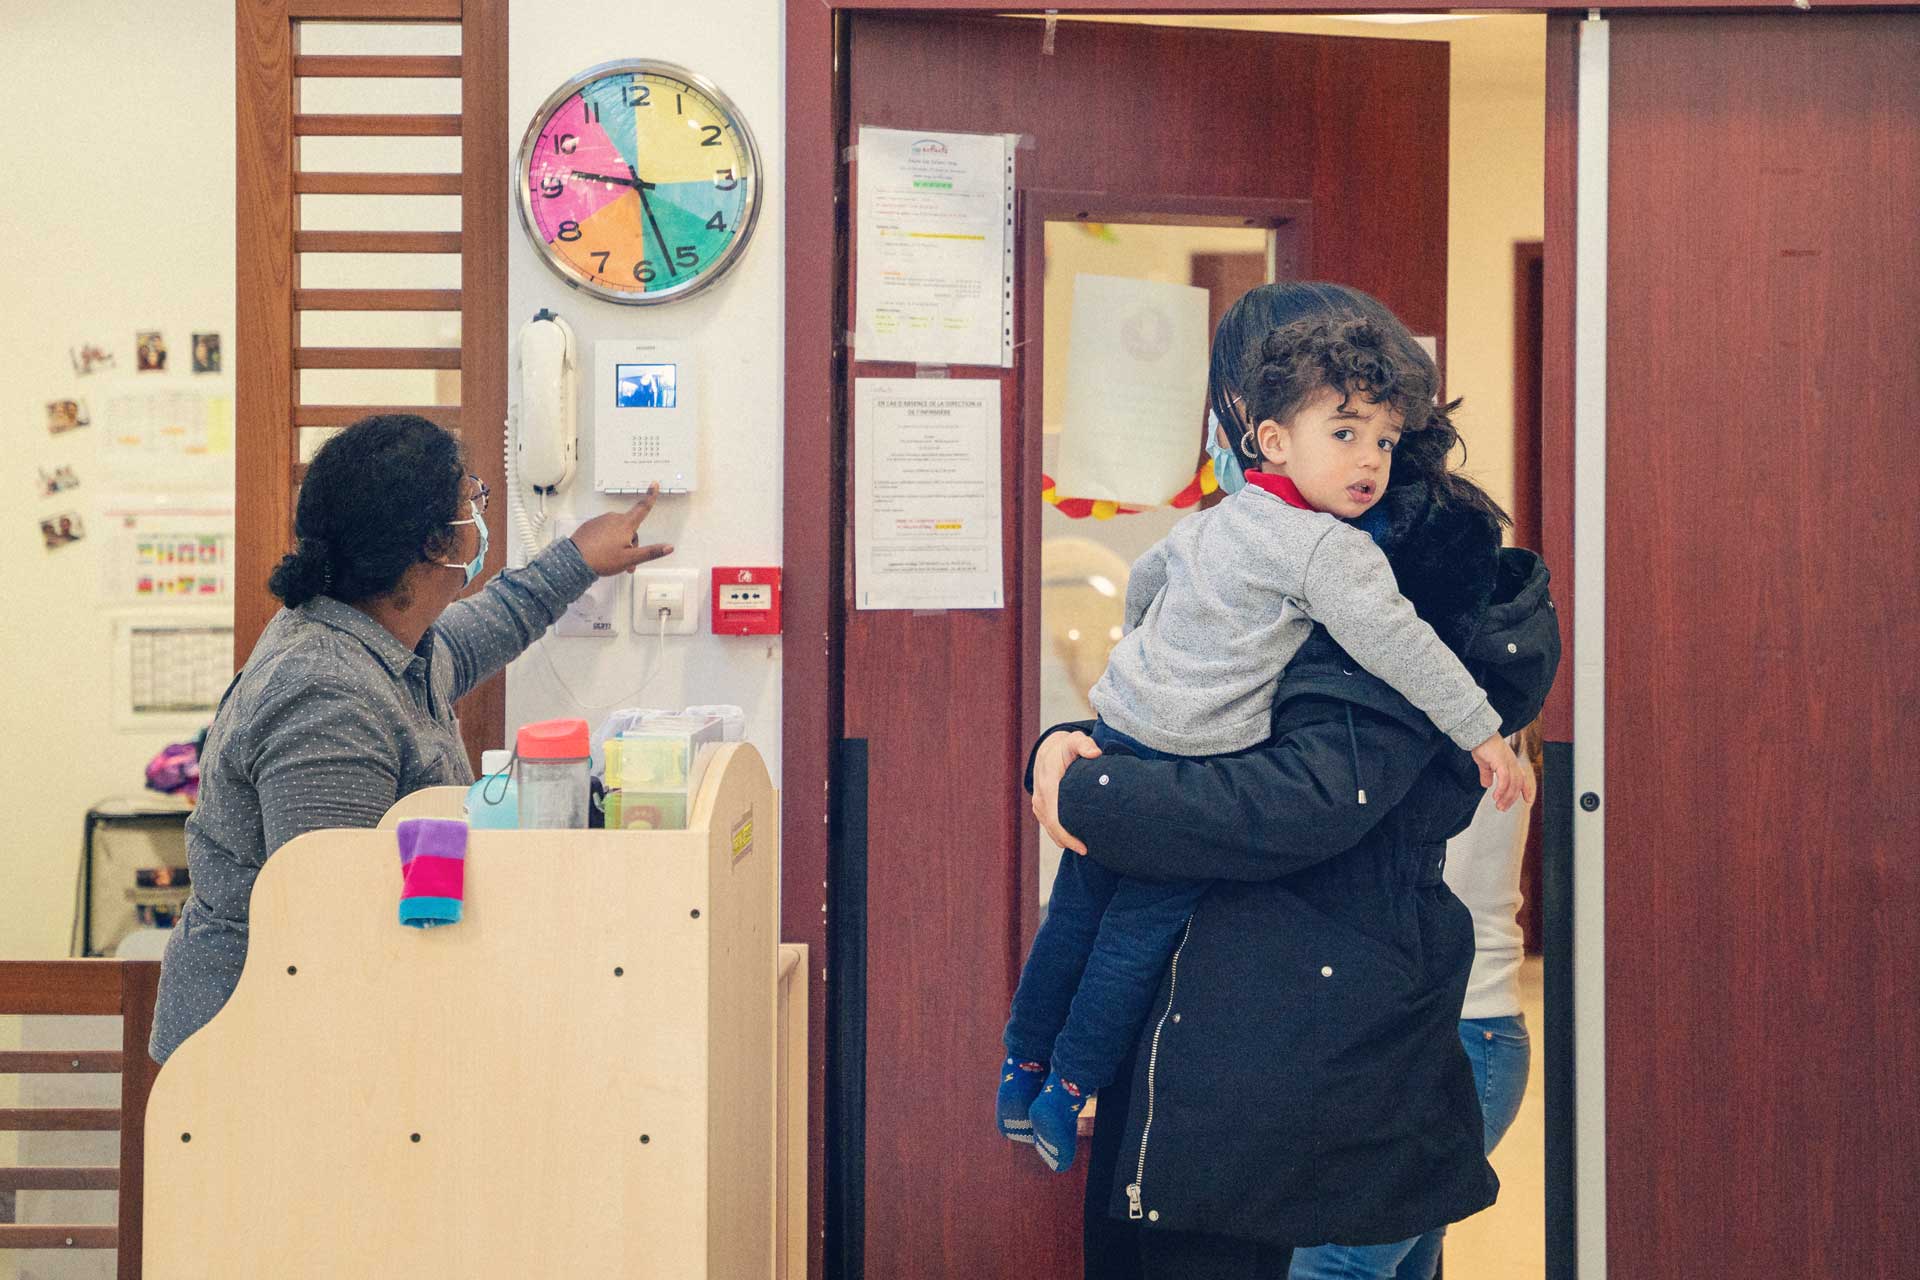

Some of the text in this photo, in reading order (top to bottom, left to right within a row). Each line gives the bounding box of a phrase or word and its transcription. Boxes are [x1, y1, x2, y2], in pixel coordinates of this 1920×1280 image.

[622, 86, 651, 107] 12
[676, 94, 683, 114] 1
[584, 102, 600, 123] 11
[554, 133, 577, 154] 10
[701, 125, 722, 146] 2
[541, 175, 564, 198] 9
[715, 169, 738, 191] 3
[557, 221, 582, 242] 8
[705, 211, 727, 232] 4
[590, 251, 611, 273] 7
[676, 246, 699, 267] 5
[633, 261, 656, 283] 6
